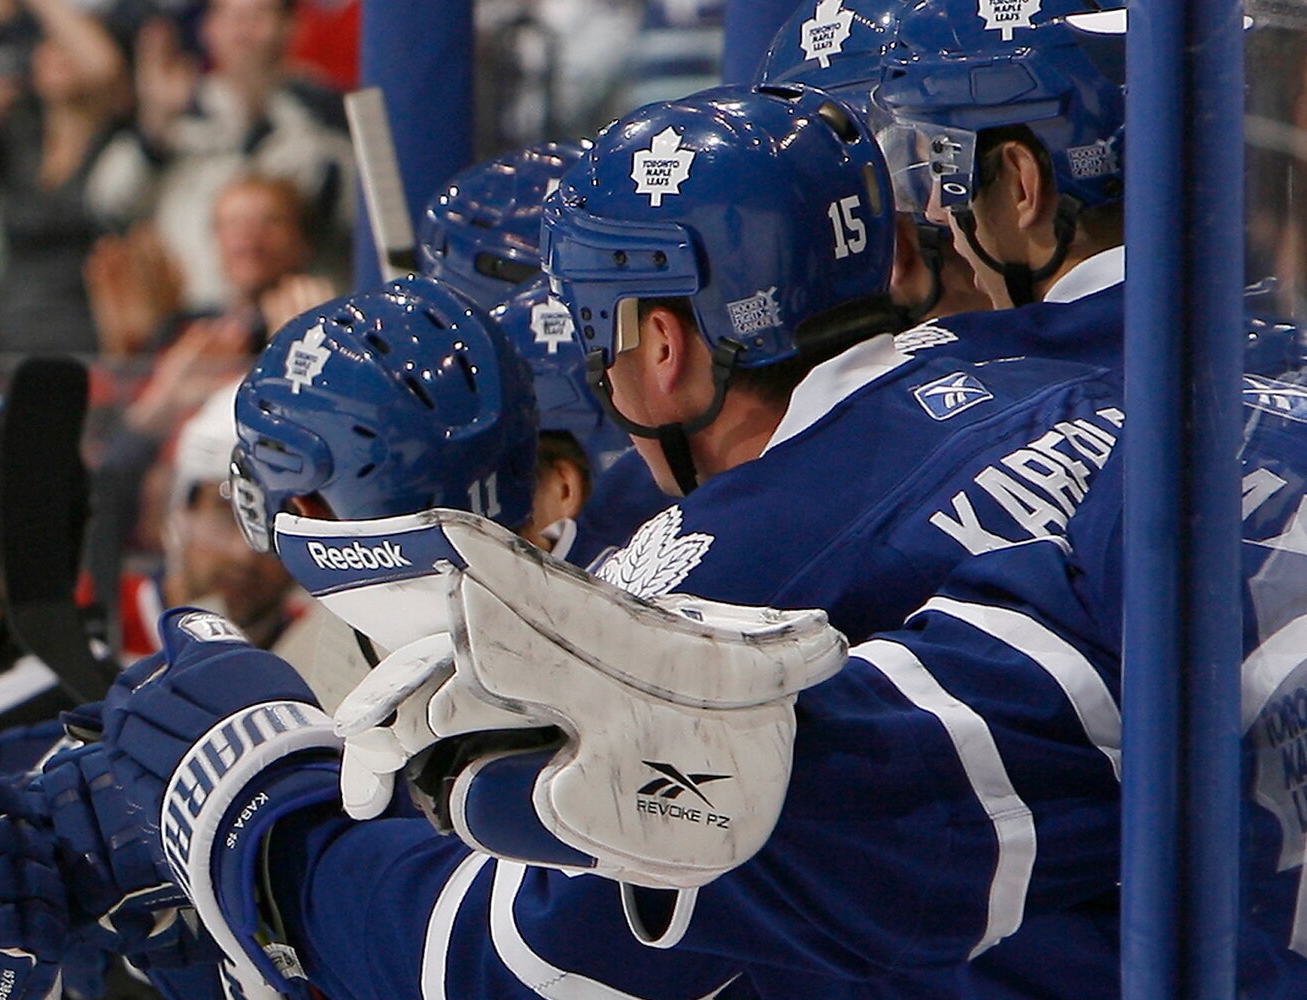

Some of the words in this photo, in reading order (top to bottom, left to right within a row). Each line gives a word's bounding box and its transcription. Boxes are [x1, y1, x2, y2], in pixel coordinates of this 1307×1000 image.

[827, 194, 868, 260] 15
[306, 540, 414, 571] Reebok
[636, 799, 702, 824] REVOKE
[706, 812, 731, 830] PZ
